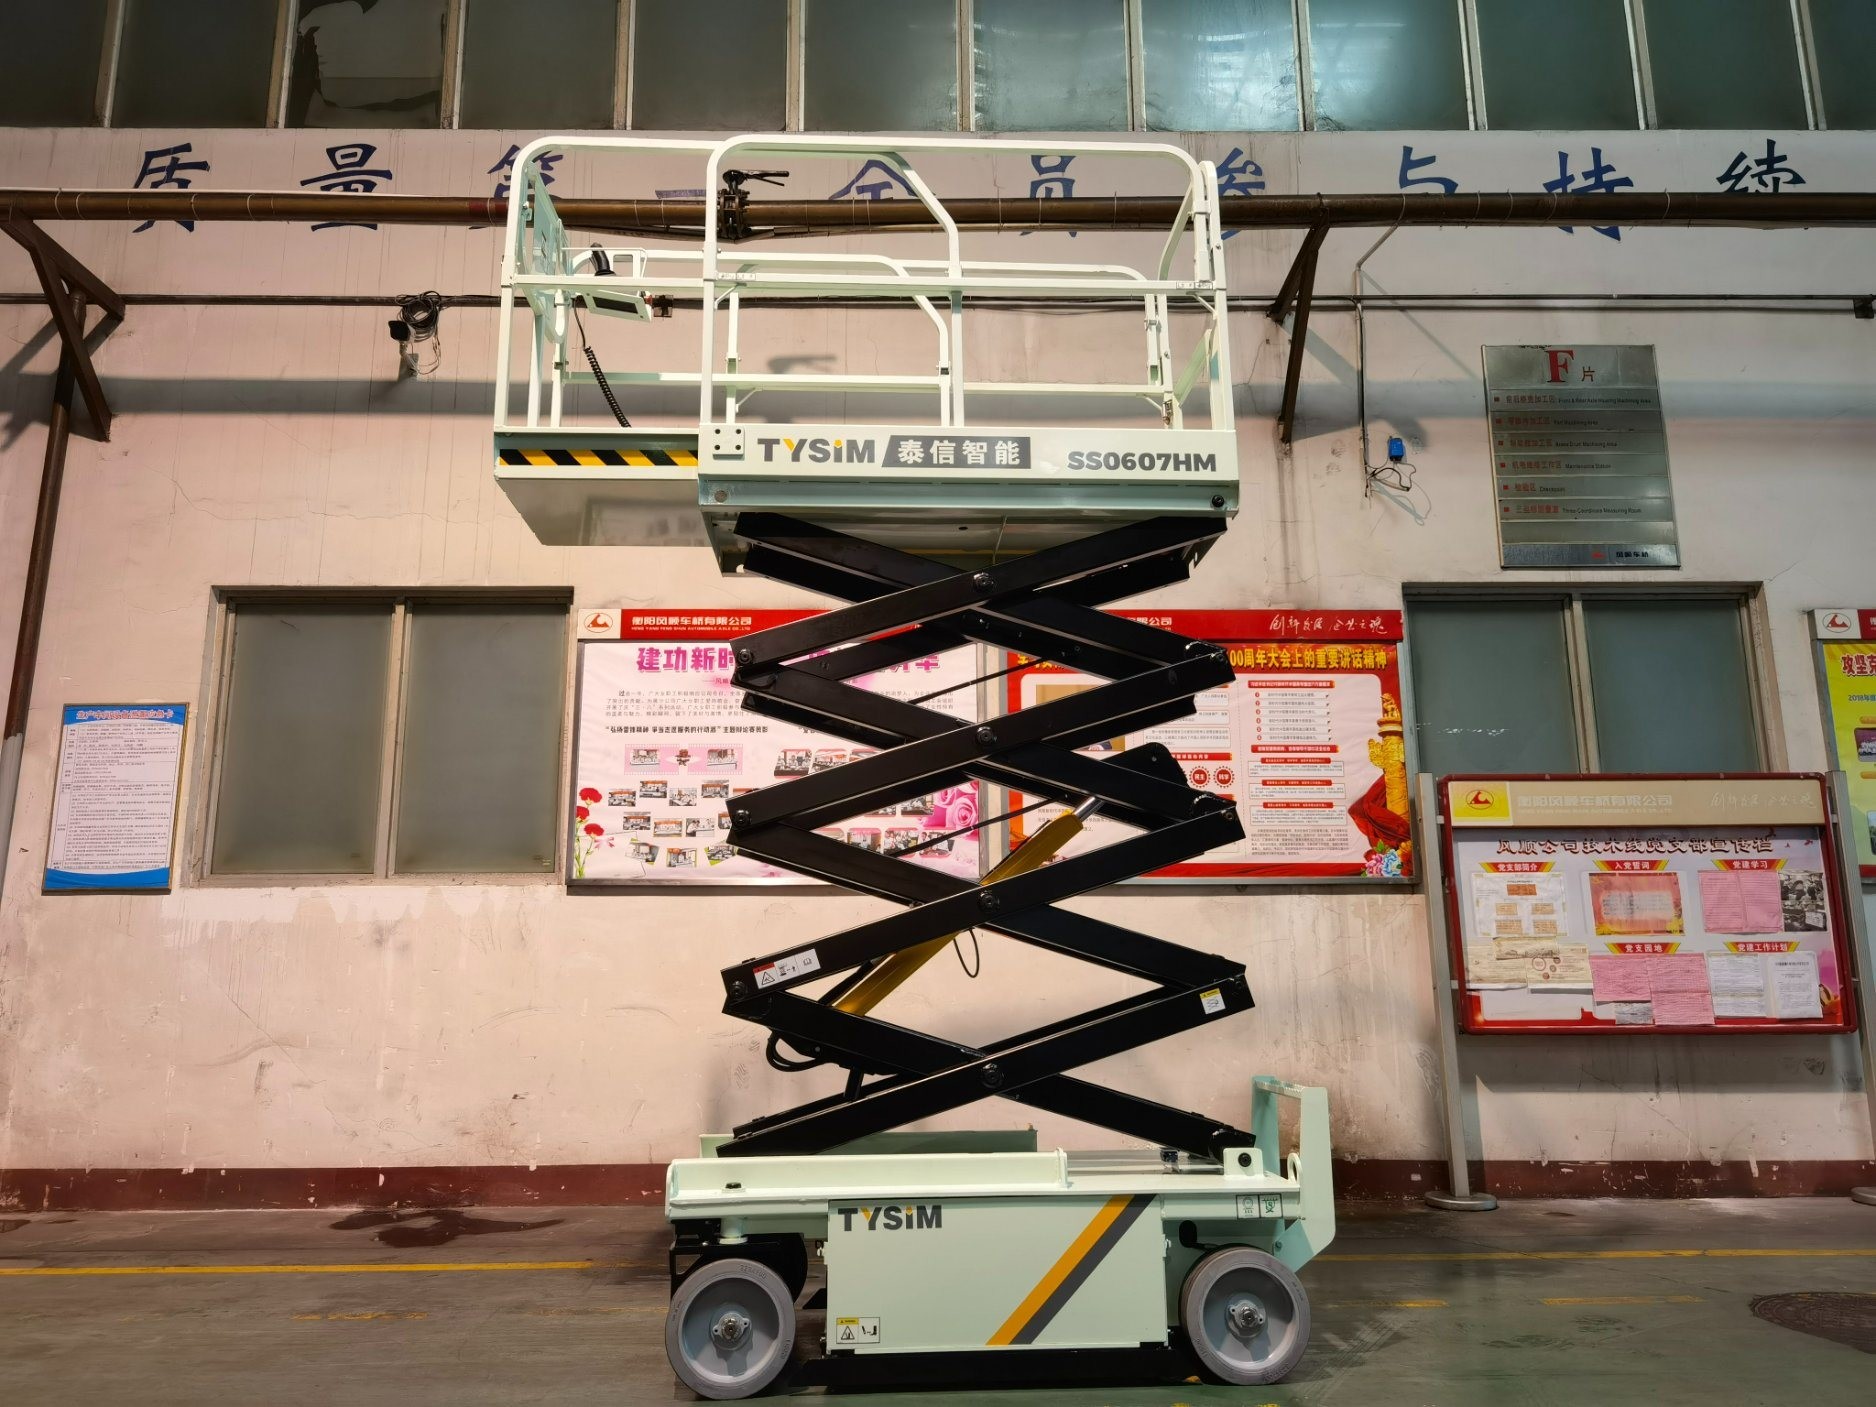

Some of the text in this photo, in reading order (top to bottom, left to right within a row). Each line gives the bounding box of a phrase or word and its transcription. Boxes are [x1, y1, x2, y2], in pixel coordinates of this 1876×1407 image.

[1545, 350, 1575, 383] F
[897, 439, 1020, 465] 泰信智能
[1067, 450, 1217, 472] SS0607HM
[1732, 860, 1768, 869] 党建学习
